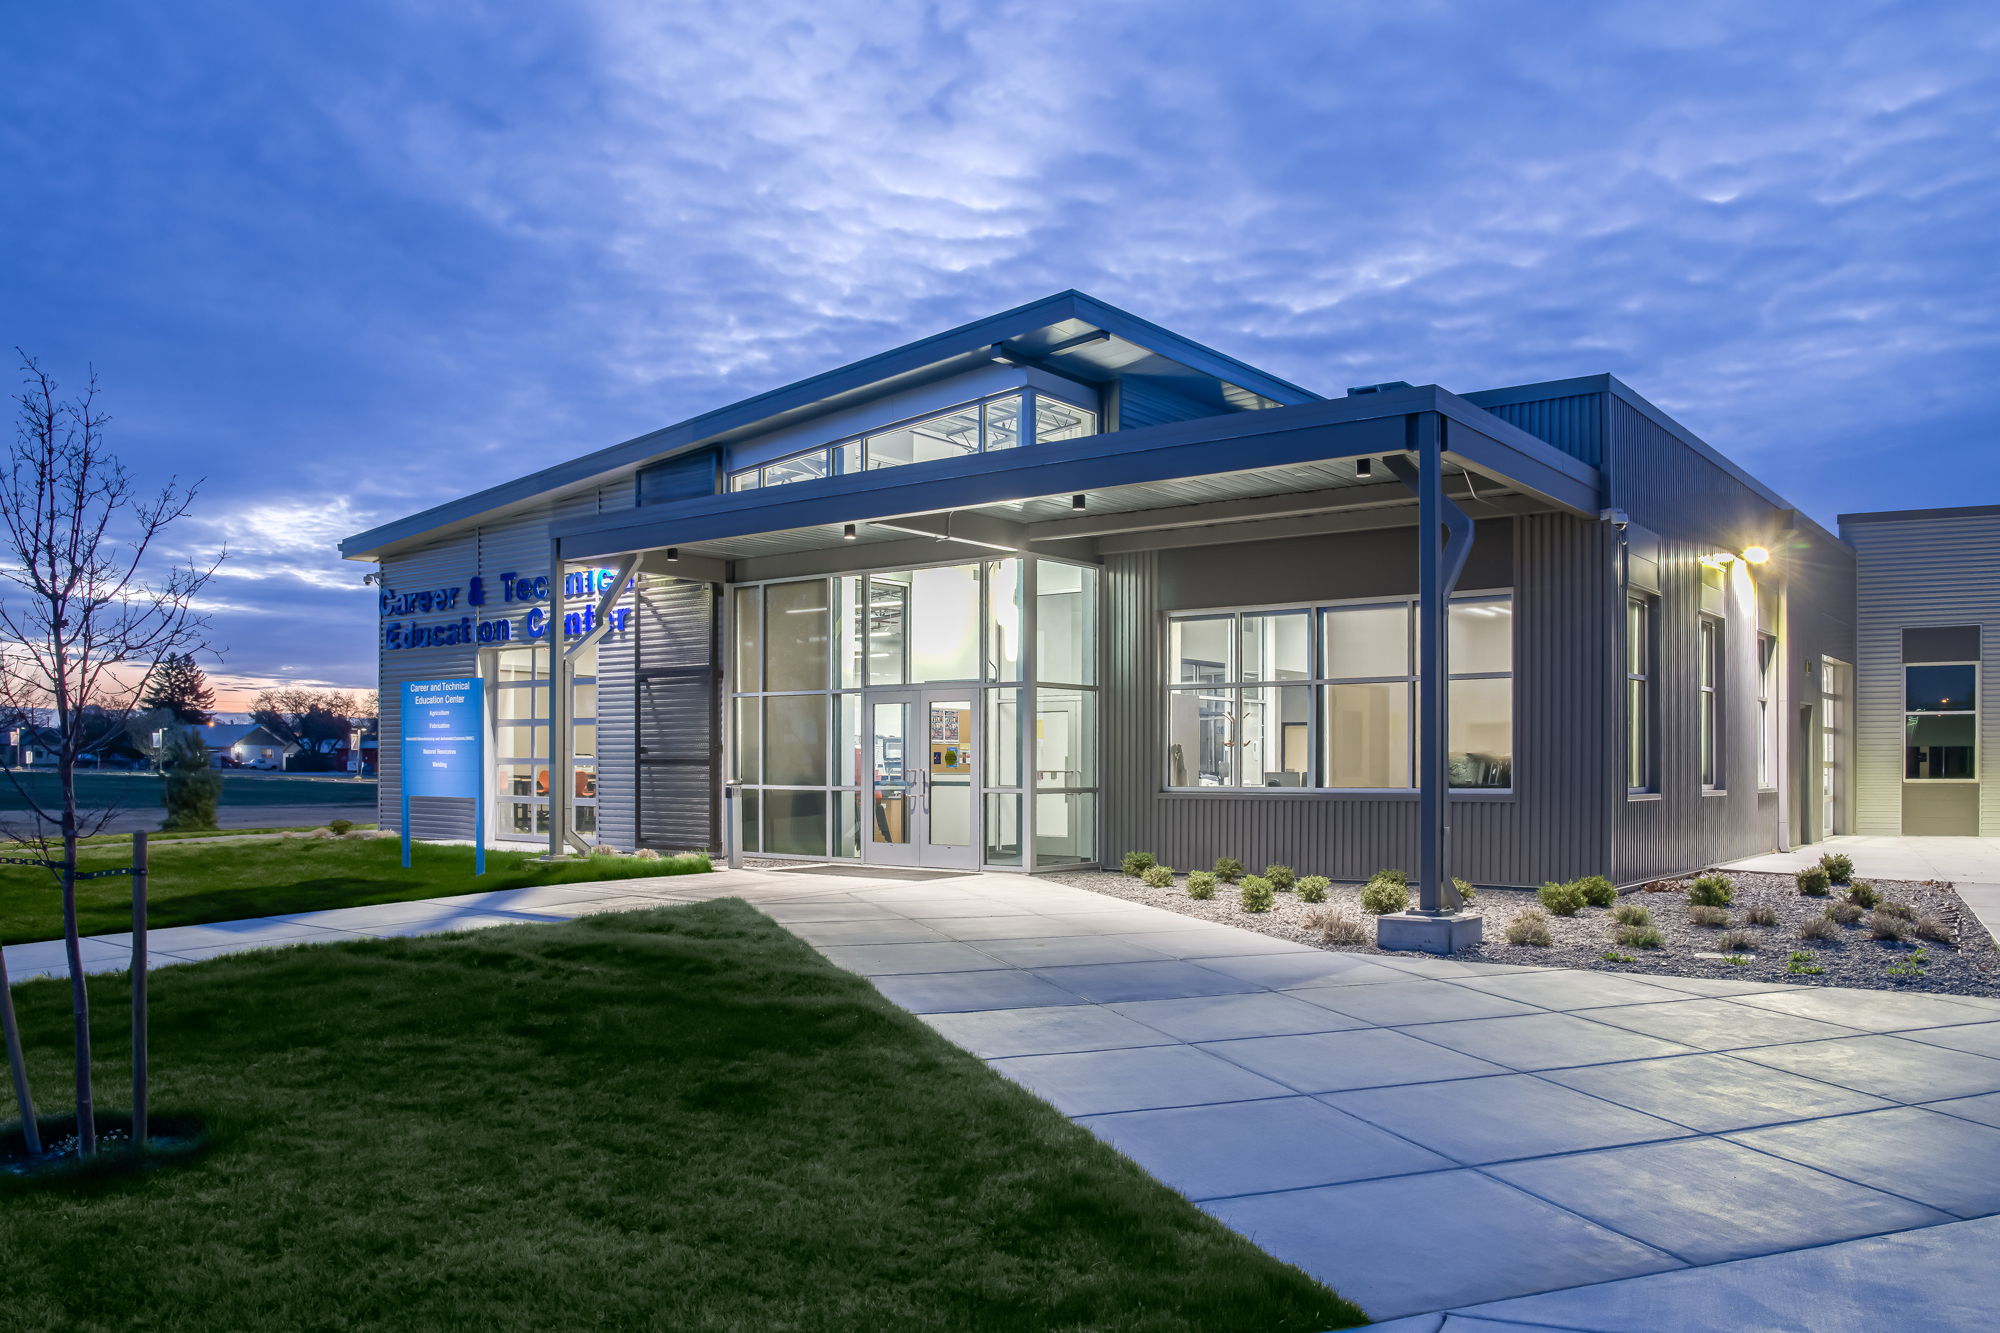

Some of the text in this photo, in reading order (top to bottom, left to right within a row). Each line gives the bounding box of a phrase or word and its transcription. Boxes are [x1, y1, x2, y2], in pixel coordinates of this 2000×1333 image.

[381, 568, 635, 616] Career & Tecnic
[386, 604, 630, 650] Education Cntr
[410, 681, 470, 693] Career and Technical
[415, 694, 465, 705] Education Center
